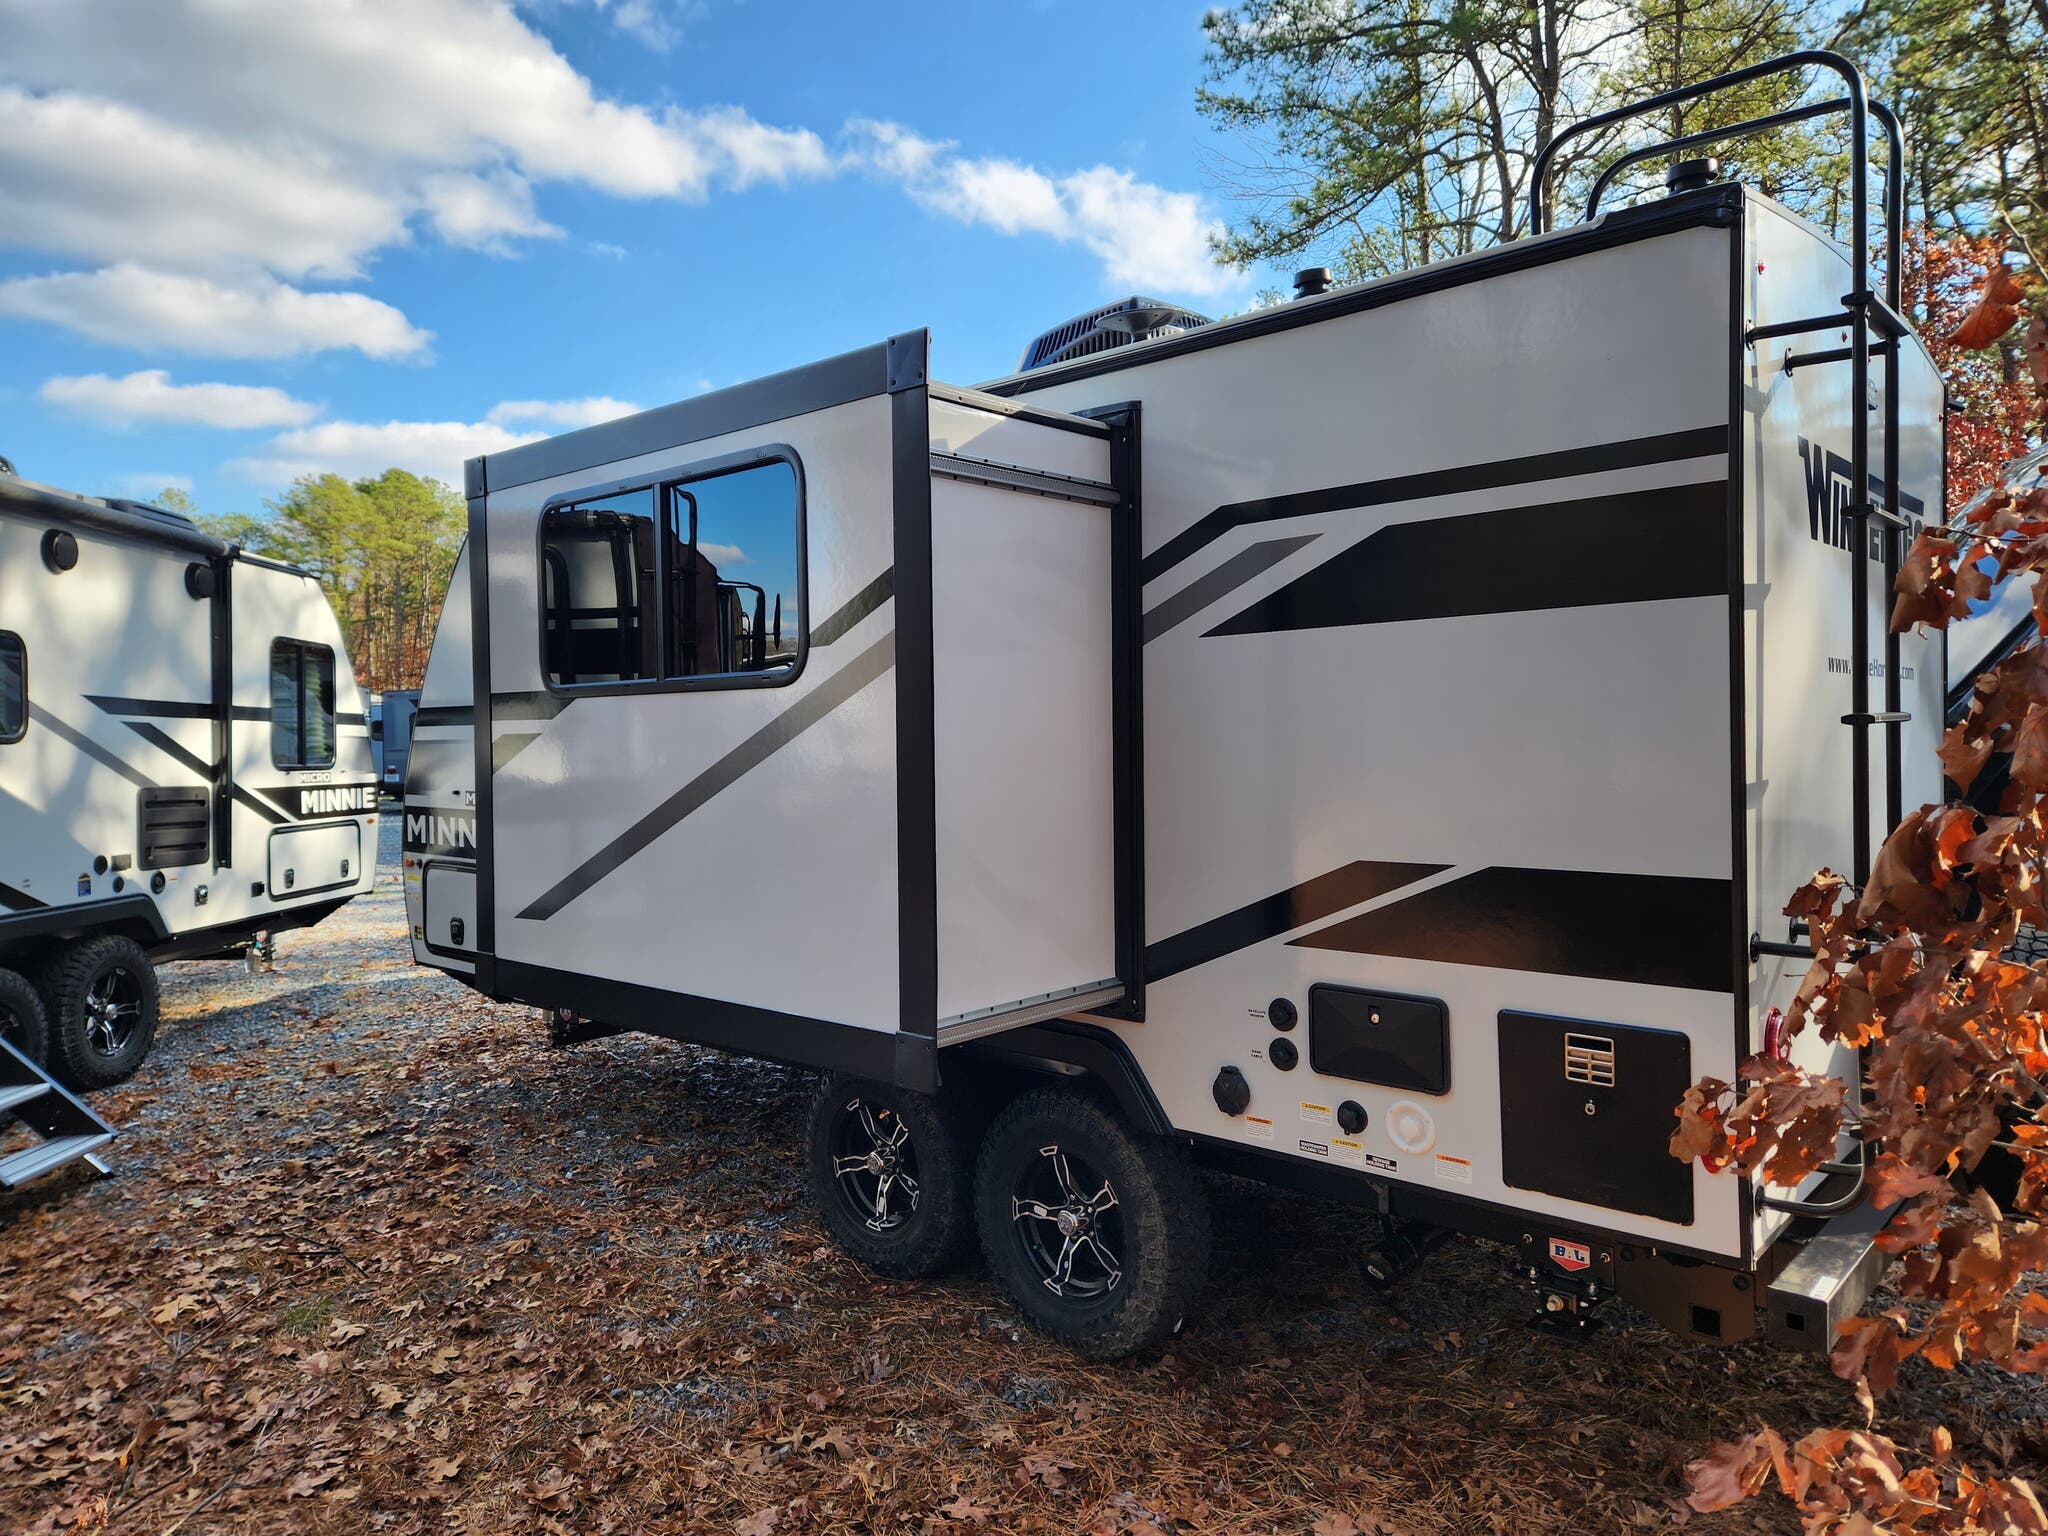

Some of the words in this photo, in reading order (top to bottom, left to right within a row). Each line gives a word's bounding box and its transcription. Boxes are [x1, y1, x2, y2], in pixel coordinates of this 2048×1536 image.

[299, 772, 331, 783] MICRO
[301, 787, 376, 814] MINNIE
[1339, 1140, 1358, 1148] CAUTION
